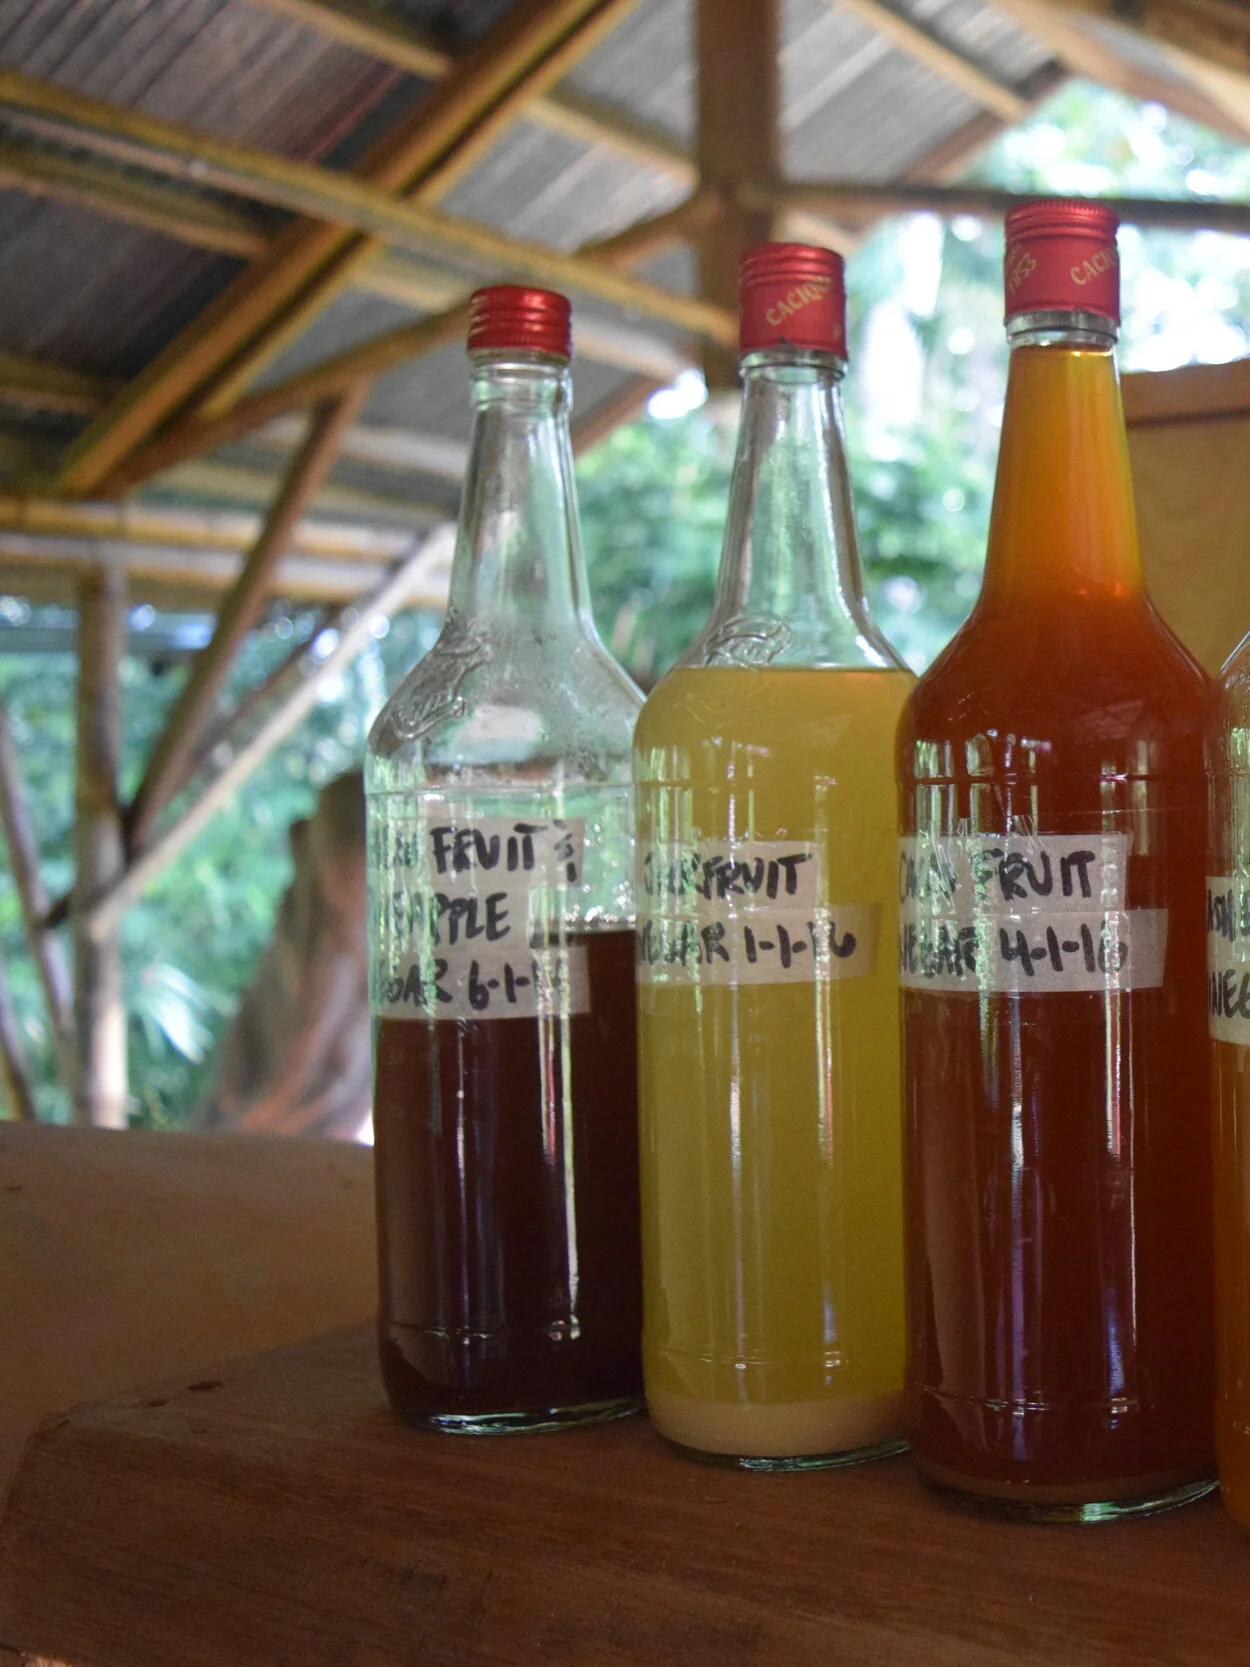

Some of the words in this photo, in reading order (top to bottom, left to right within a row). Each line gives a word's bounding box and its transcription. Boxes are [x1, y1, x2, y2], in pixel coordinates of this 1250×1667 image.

[430, 822, 549, 874] FRUIT
[971, 848, 1096, 901] FRUIT
[999, 918, 1129, 977] 4-1-16
